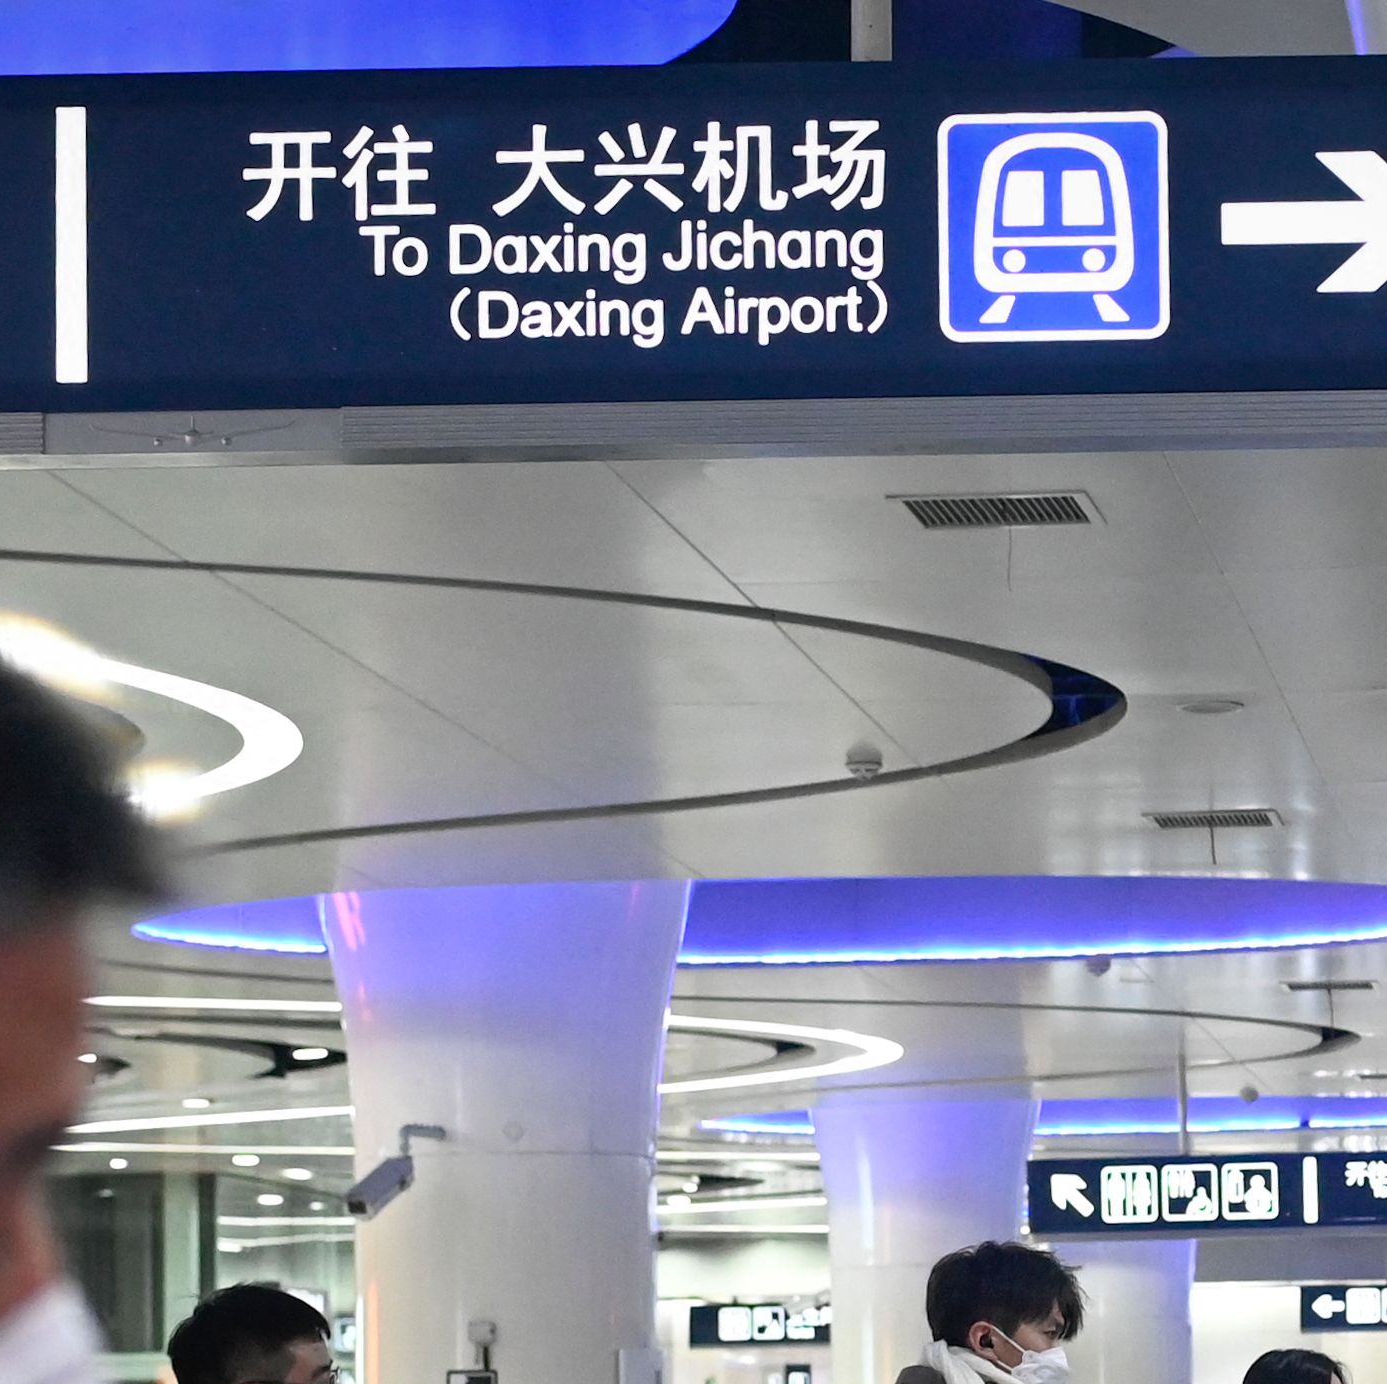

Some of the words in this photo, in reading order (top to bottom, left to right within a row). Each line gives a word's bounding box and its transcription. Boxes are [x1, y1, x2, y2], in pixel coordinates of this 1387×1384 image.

[243, 125, 436, 221] 开往
[492, 120, 885, 216] 大兴机场
[359, 226, 428, 276] To
[449, 223, 646, 285] Daxing
[662, 219, 883, 281] Jichang
[450, 287, 664, 348] (Daxing
[681, 281, 888, 345] Airport)
